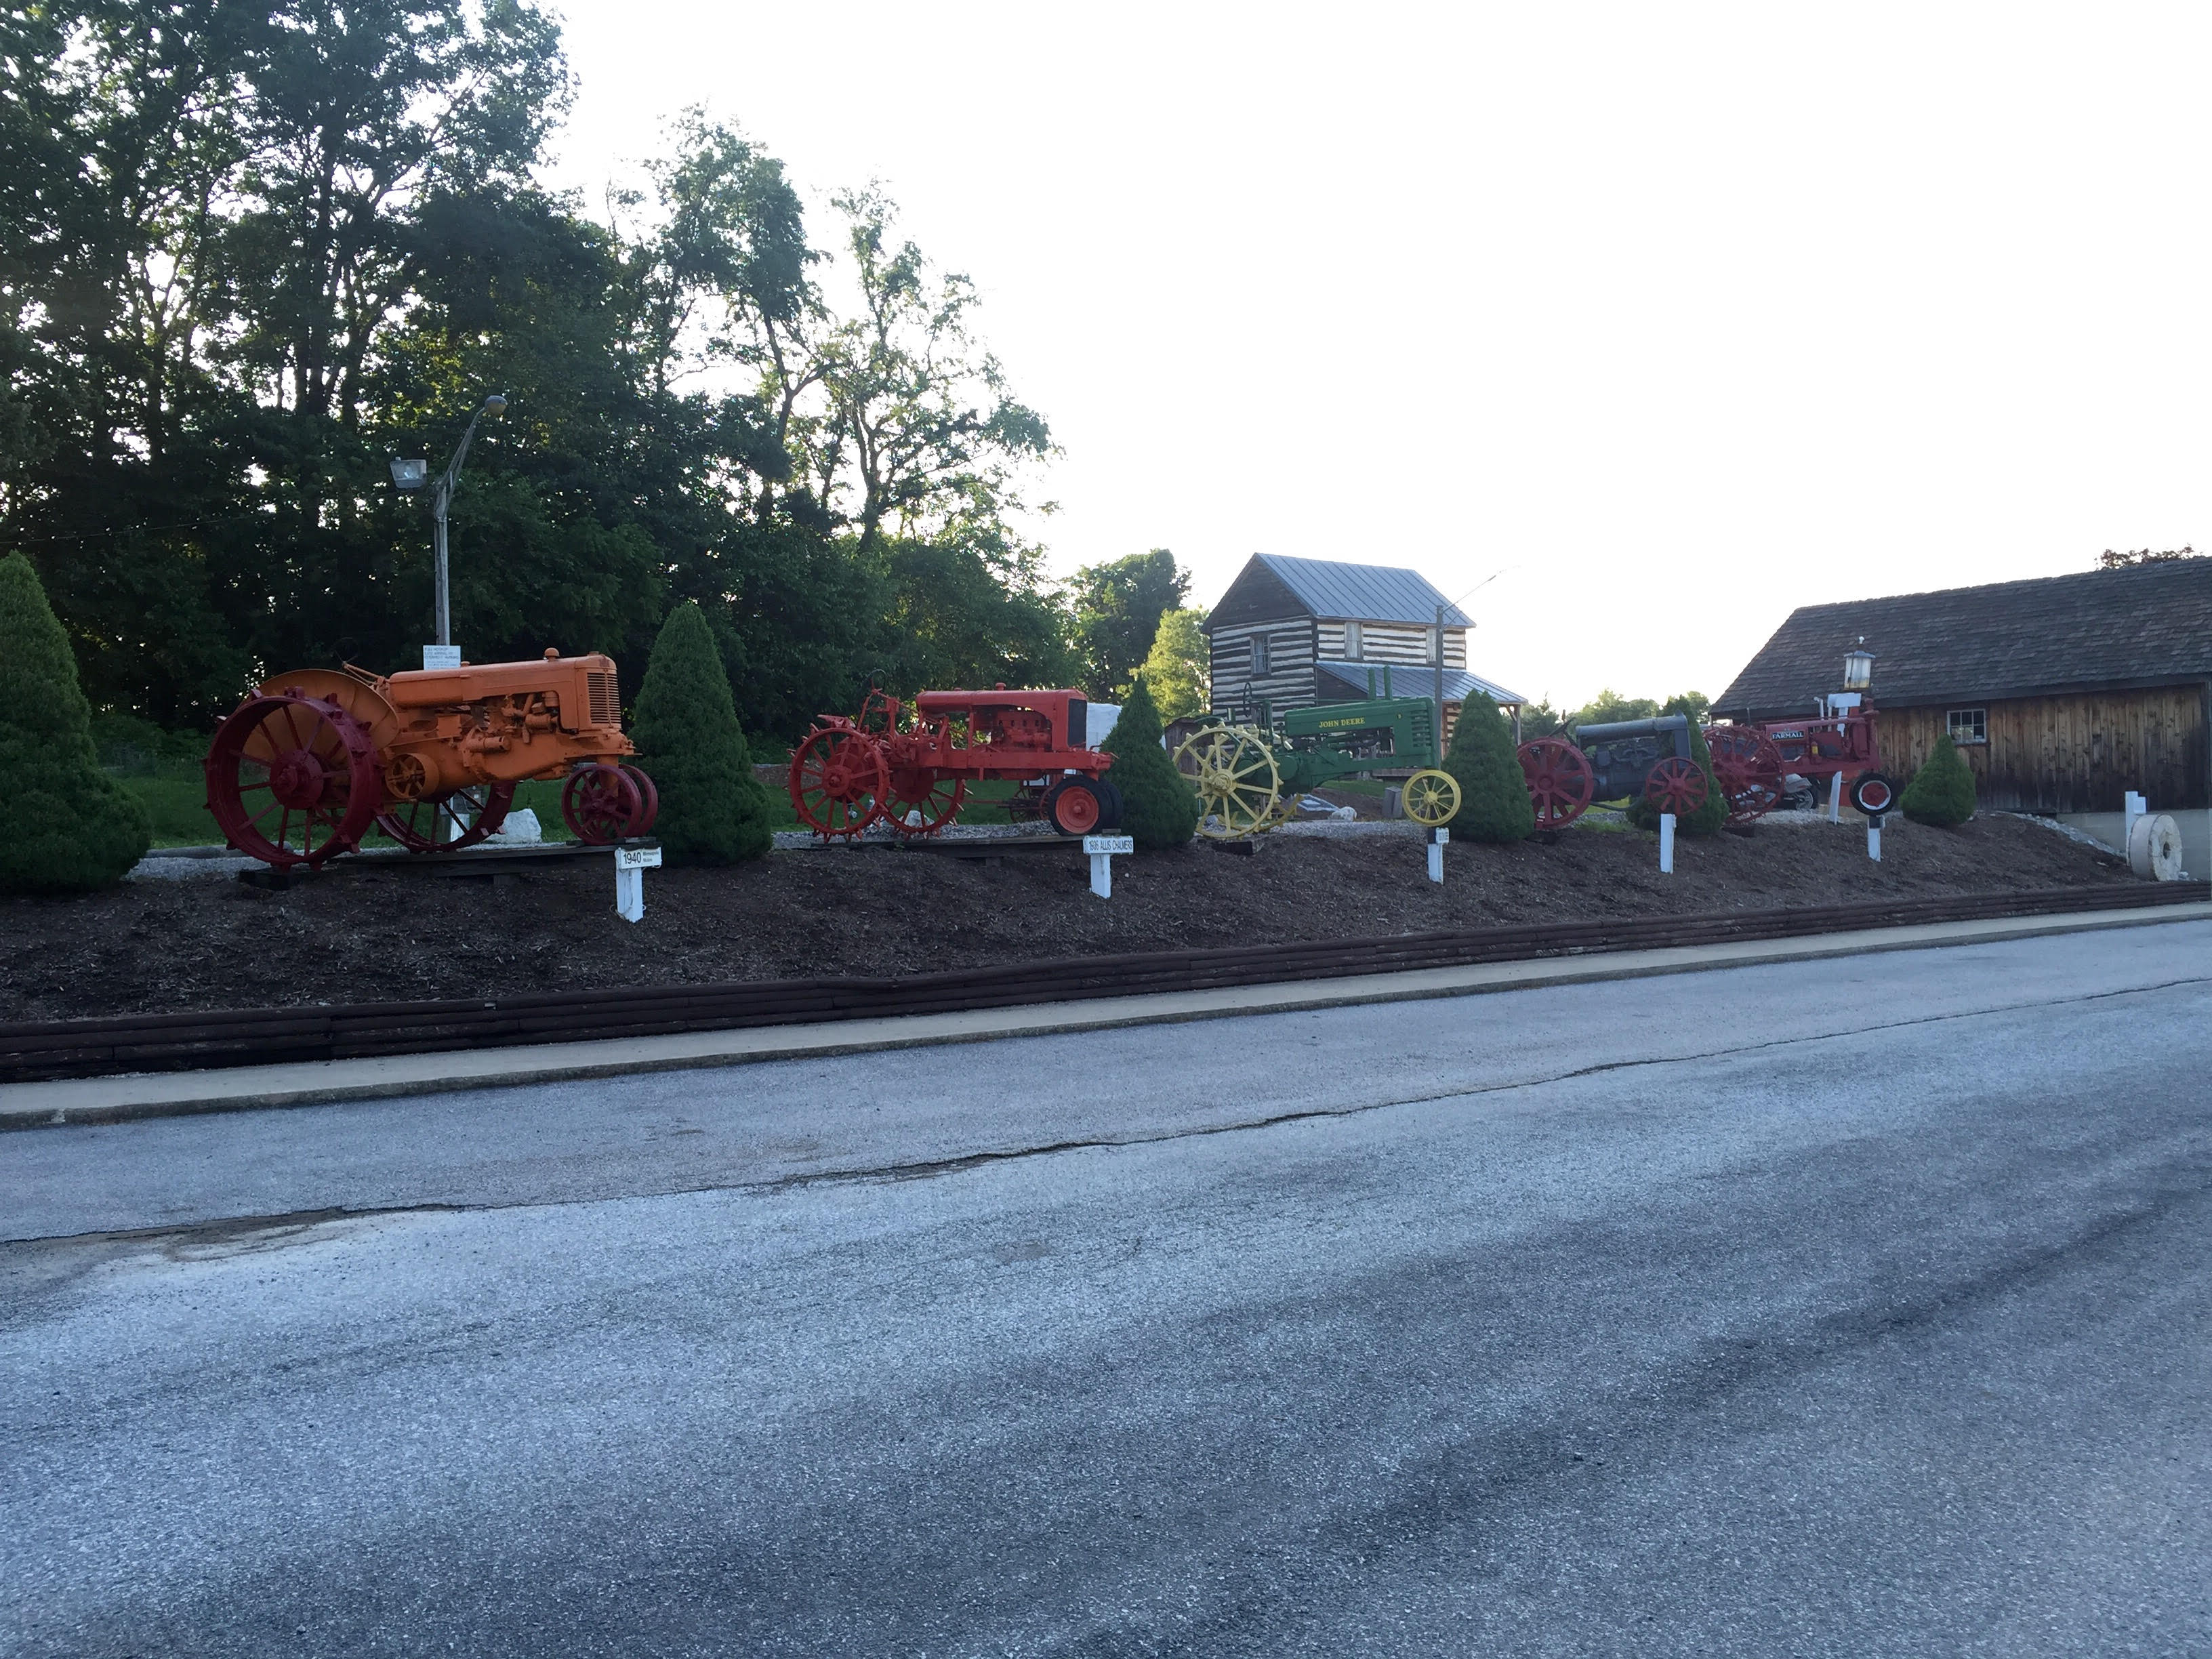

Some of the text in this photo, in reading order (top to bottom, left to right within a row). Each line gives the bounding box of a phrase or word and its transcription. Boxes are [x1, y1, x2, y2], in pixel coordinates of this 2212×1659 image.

[1319, 717, 1366, 728] JOHN DEERE
[1772, 731, 1804, 739] FARMALL
[1100, 840, 1111, 851] ALLIS
[1112, 840, 1132, 851] CHALMERS
[623, 852, 642, 865] 1940
